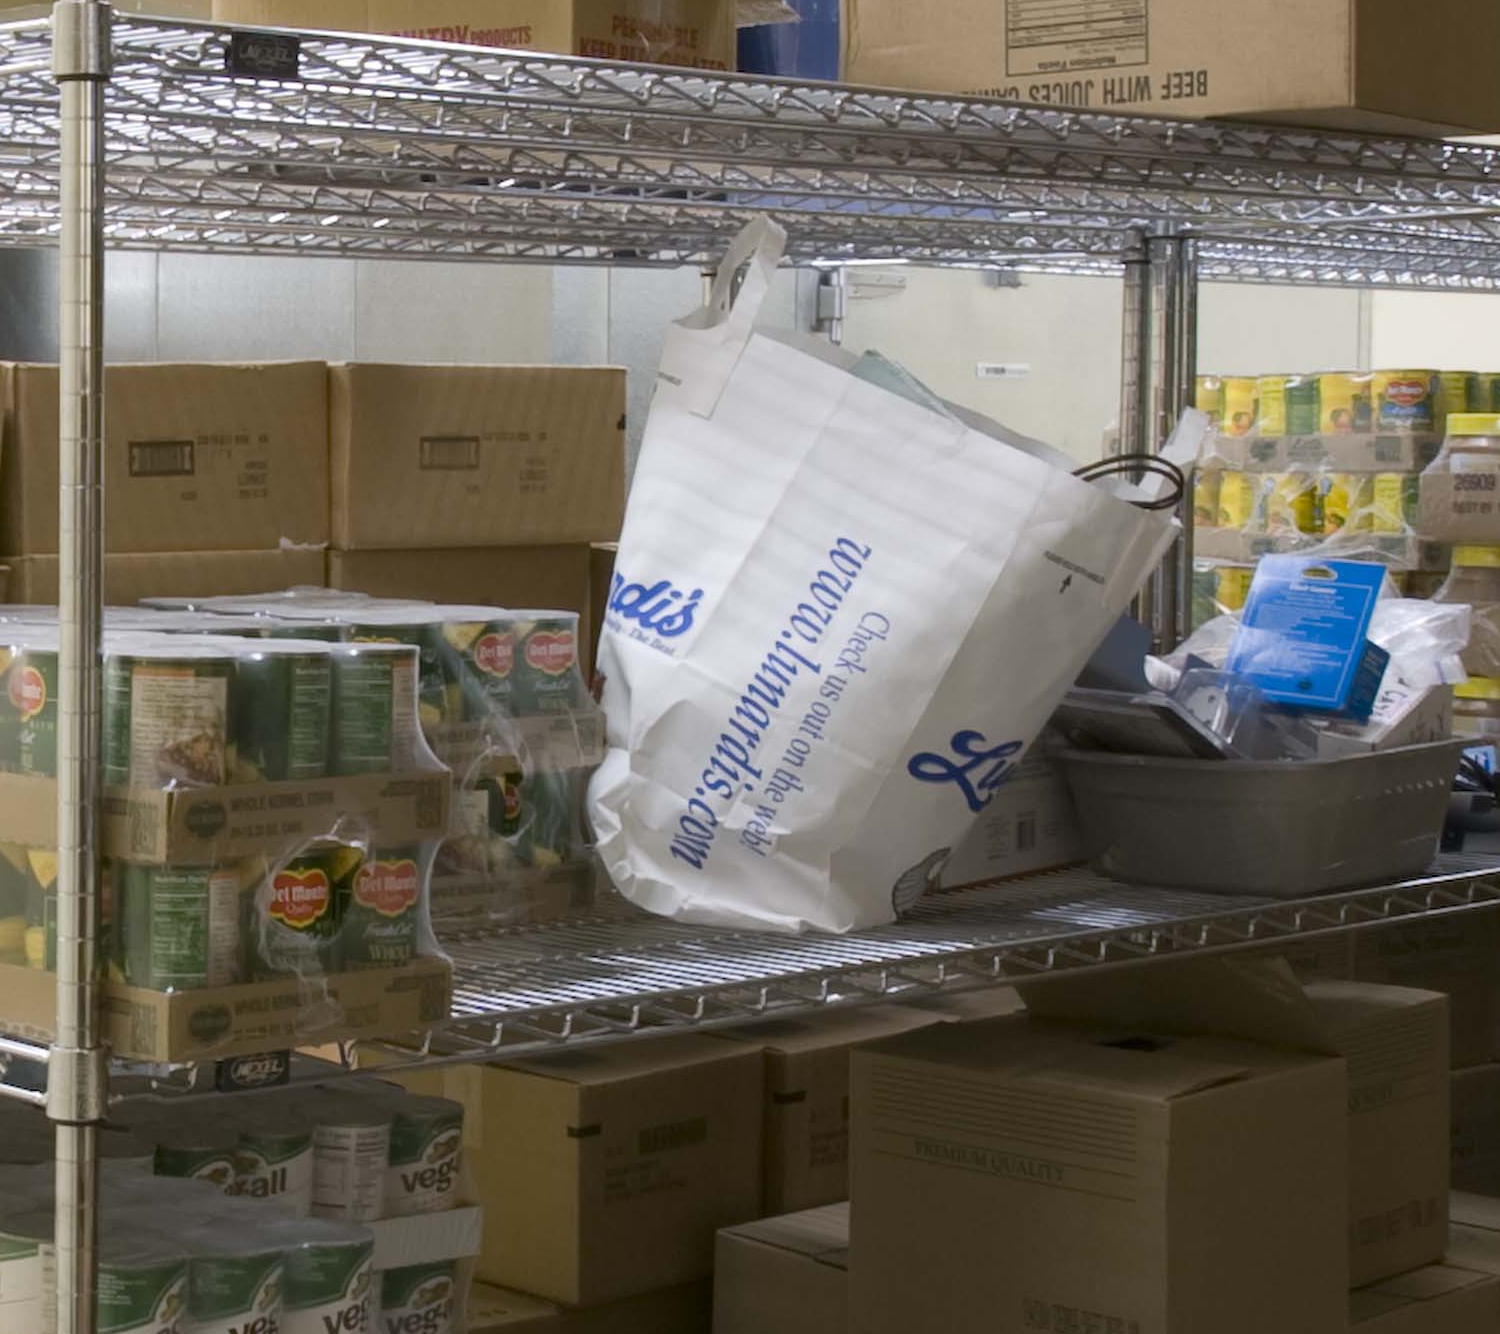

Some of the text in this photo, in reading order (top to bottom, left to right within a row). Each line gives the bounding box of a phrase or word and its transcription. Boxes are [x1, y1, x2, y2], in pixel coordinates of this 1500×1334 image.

[1028, 80, 1094, 106] JUICES
[1103, 75, 1152, 104] WITH
[1161, 70, 1208, 100] BEEF
[609, 571, 704, 638] di's
[837, 611, 891, 675] Check
[670, 537, 872, 870] www.lunardis.com
[913, 1139, 1065, 1183] PREMIUM QUALITY
